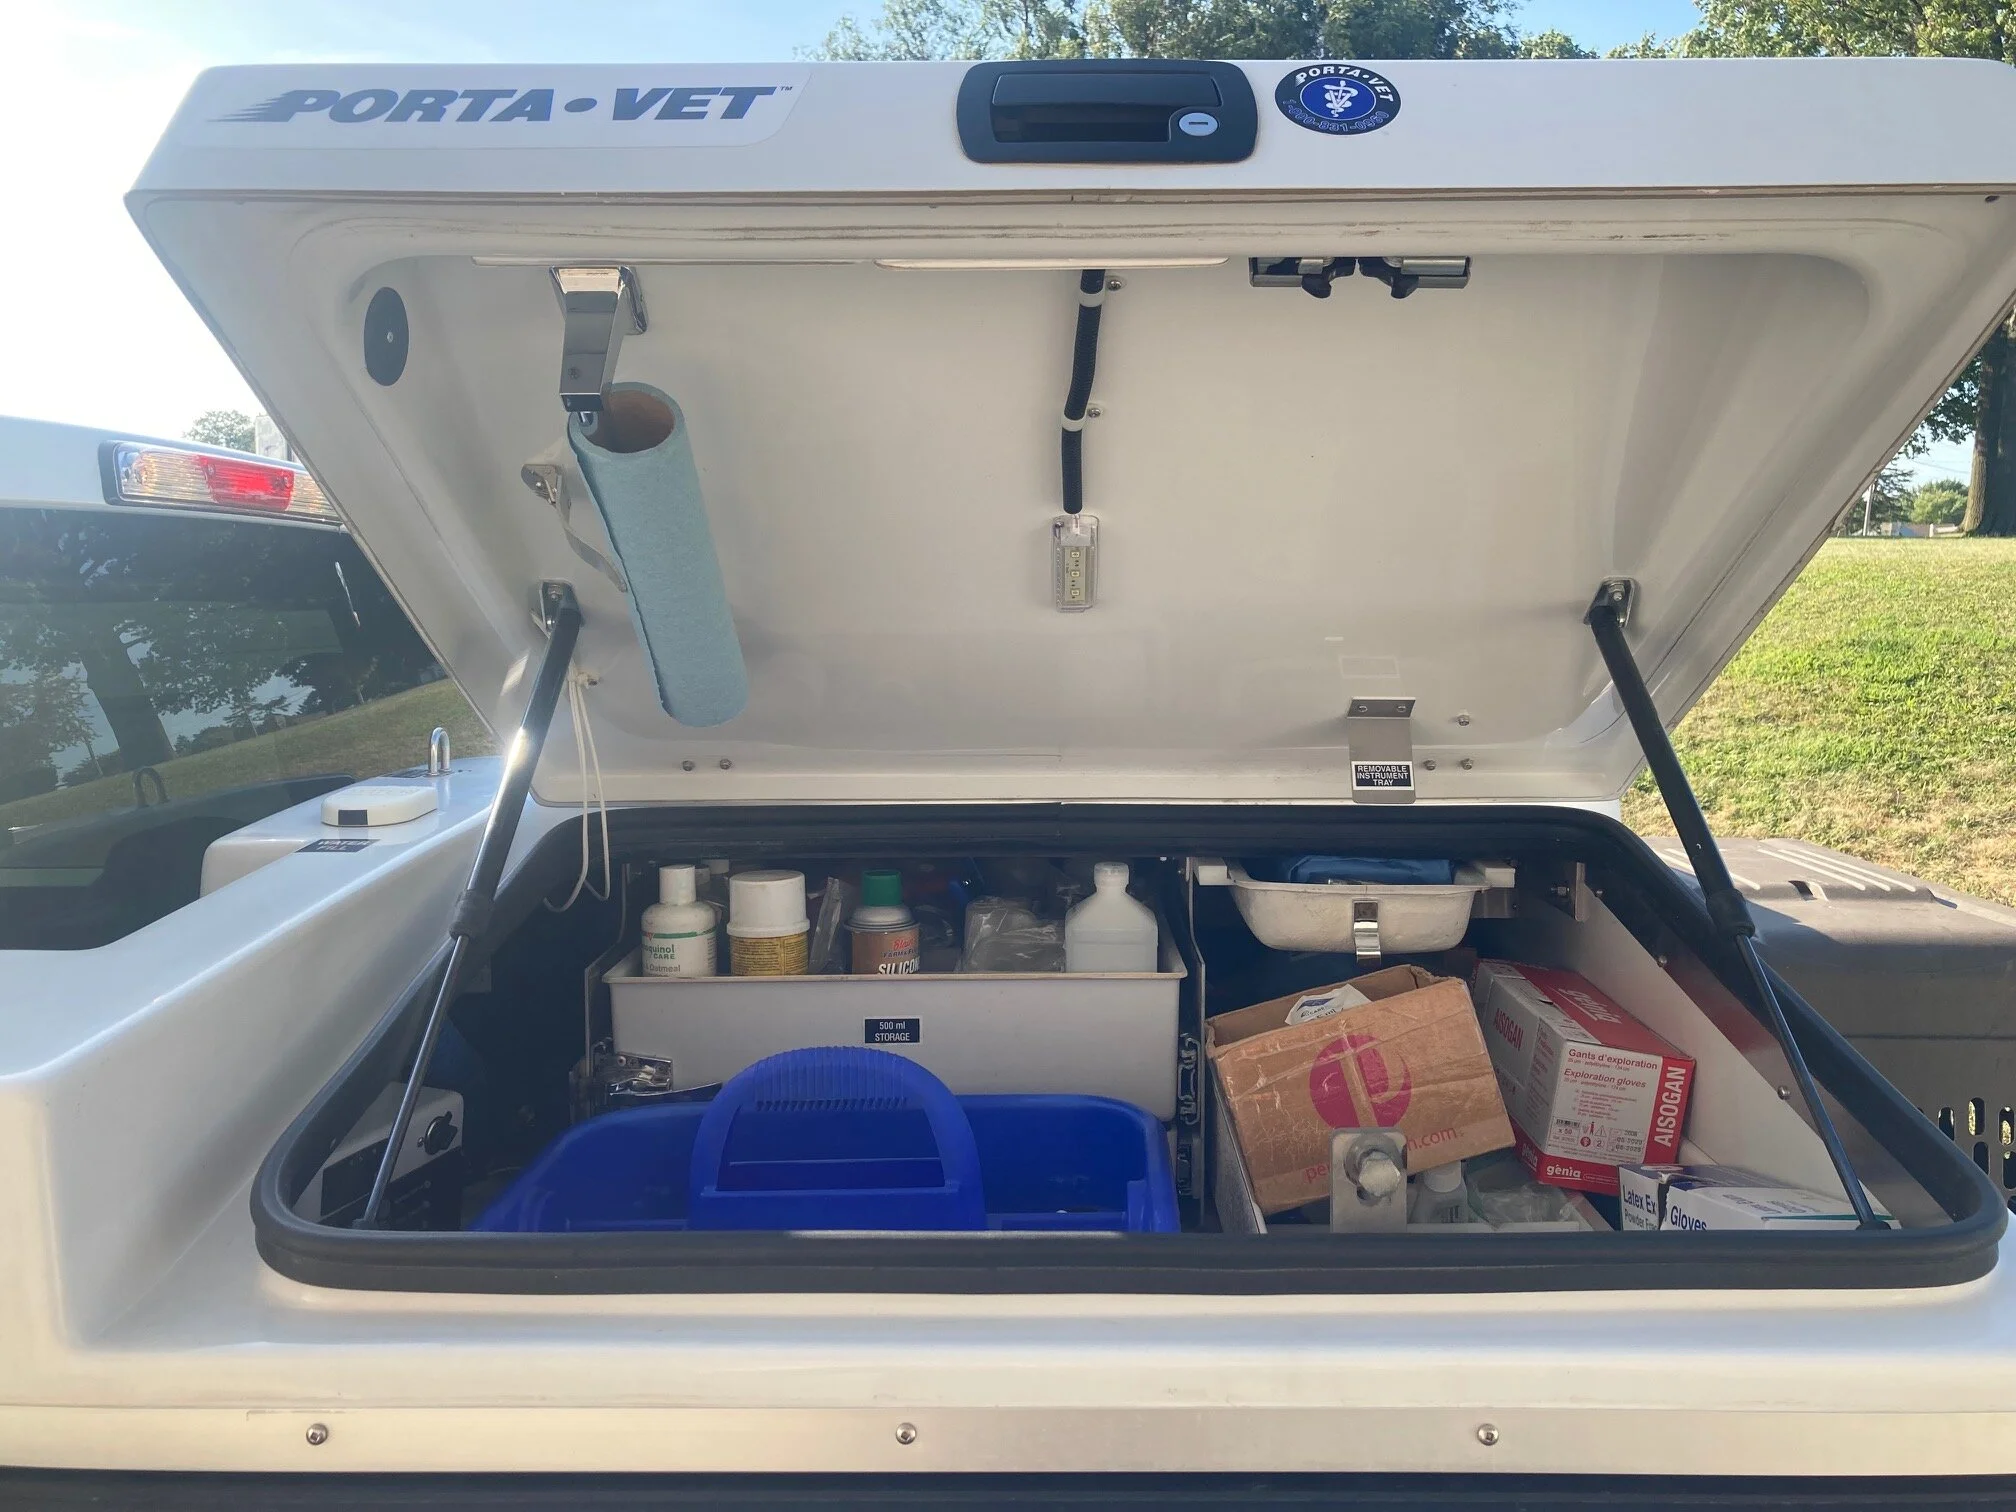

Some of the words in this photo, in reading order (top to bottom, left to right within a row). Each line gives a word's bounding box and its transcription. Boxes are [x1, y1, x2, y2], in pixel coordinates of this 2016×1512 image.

[1357, 765, 1407, 773] REMOVABLE
[1356, 772, 1409, 780] INSTRUMENT
[649, 963, 681, 973] Oatmeal
[879, 1021, 894, 1030] 500
[895, 1021, 906, 1030] ml
[1493, 1008, 1525, 1051] AISOGAN
[874, 1032, 911, 1042] STORAGE
[1568, 1048, 1597, 1061] Gants
[1563, 1068, 1616, 1084] Exploration
[1616, 1075, 1648, 1089] gloves
[1653, 1066, 1686, 1147] AISOGAN
[1622, 1184, 1645, 1211] Latex
[1670, 1205, 1708, 1231] Gloves
